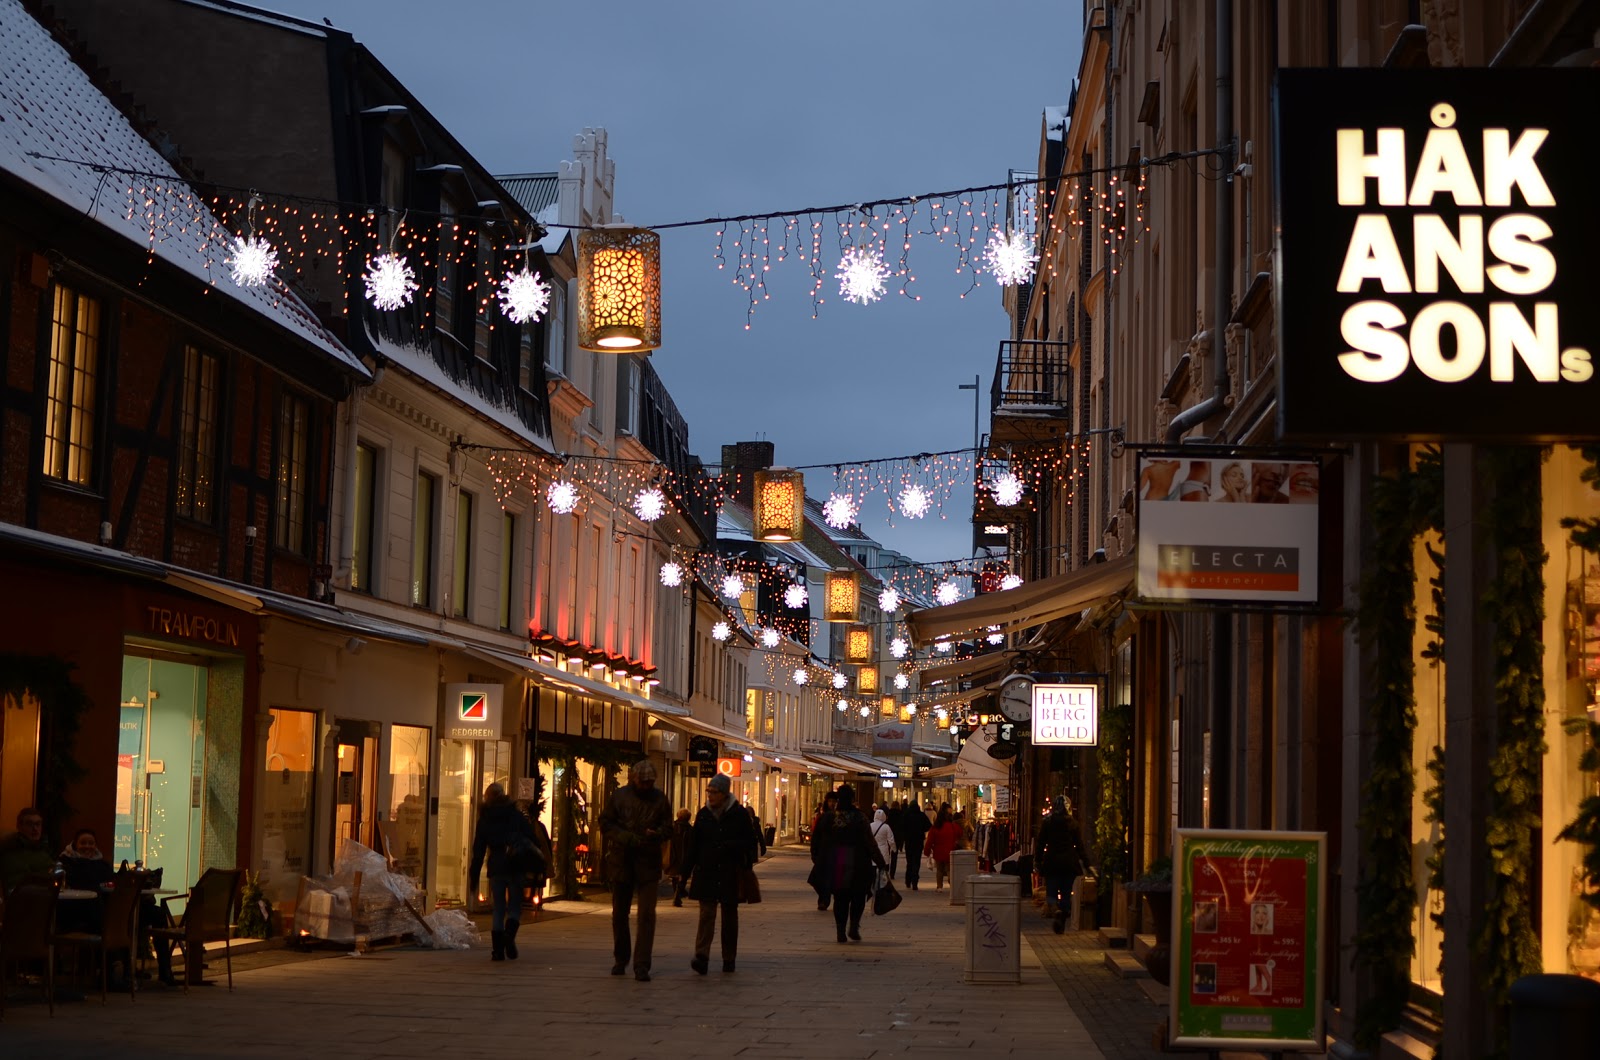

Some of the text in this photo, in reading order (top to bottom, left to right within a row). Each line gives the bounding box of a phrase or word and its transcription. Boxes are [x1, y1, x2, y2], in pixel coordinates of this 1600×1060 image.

[1337, 103, 1556, 207] HÅK
[1337, 213, 1557, 295] ANS
[1170, 551, 1287, 568] ELECTA
[1190, 575, 1265, 586] parfymeri
[146, 605, 240, 646] TRAMPOLIN
[1042, 693, 1086, 705] HALL
[1042, 708, 1086, 720] BERG
[451, 728, 494, 737] REDGREEN
[1040, 726, 1088, 739] GULD
[719, 760, 735, 777] Q
